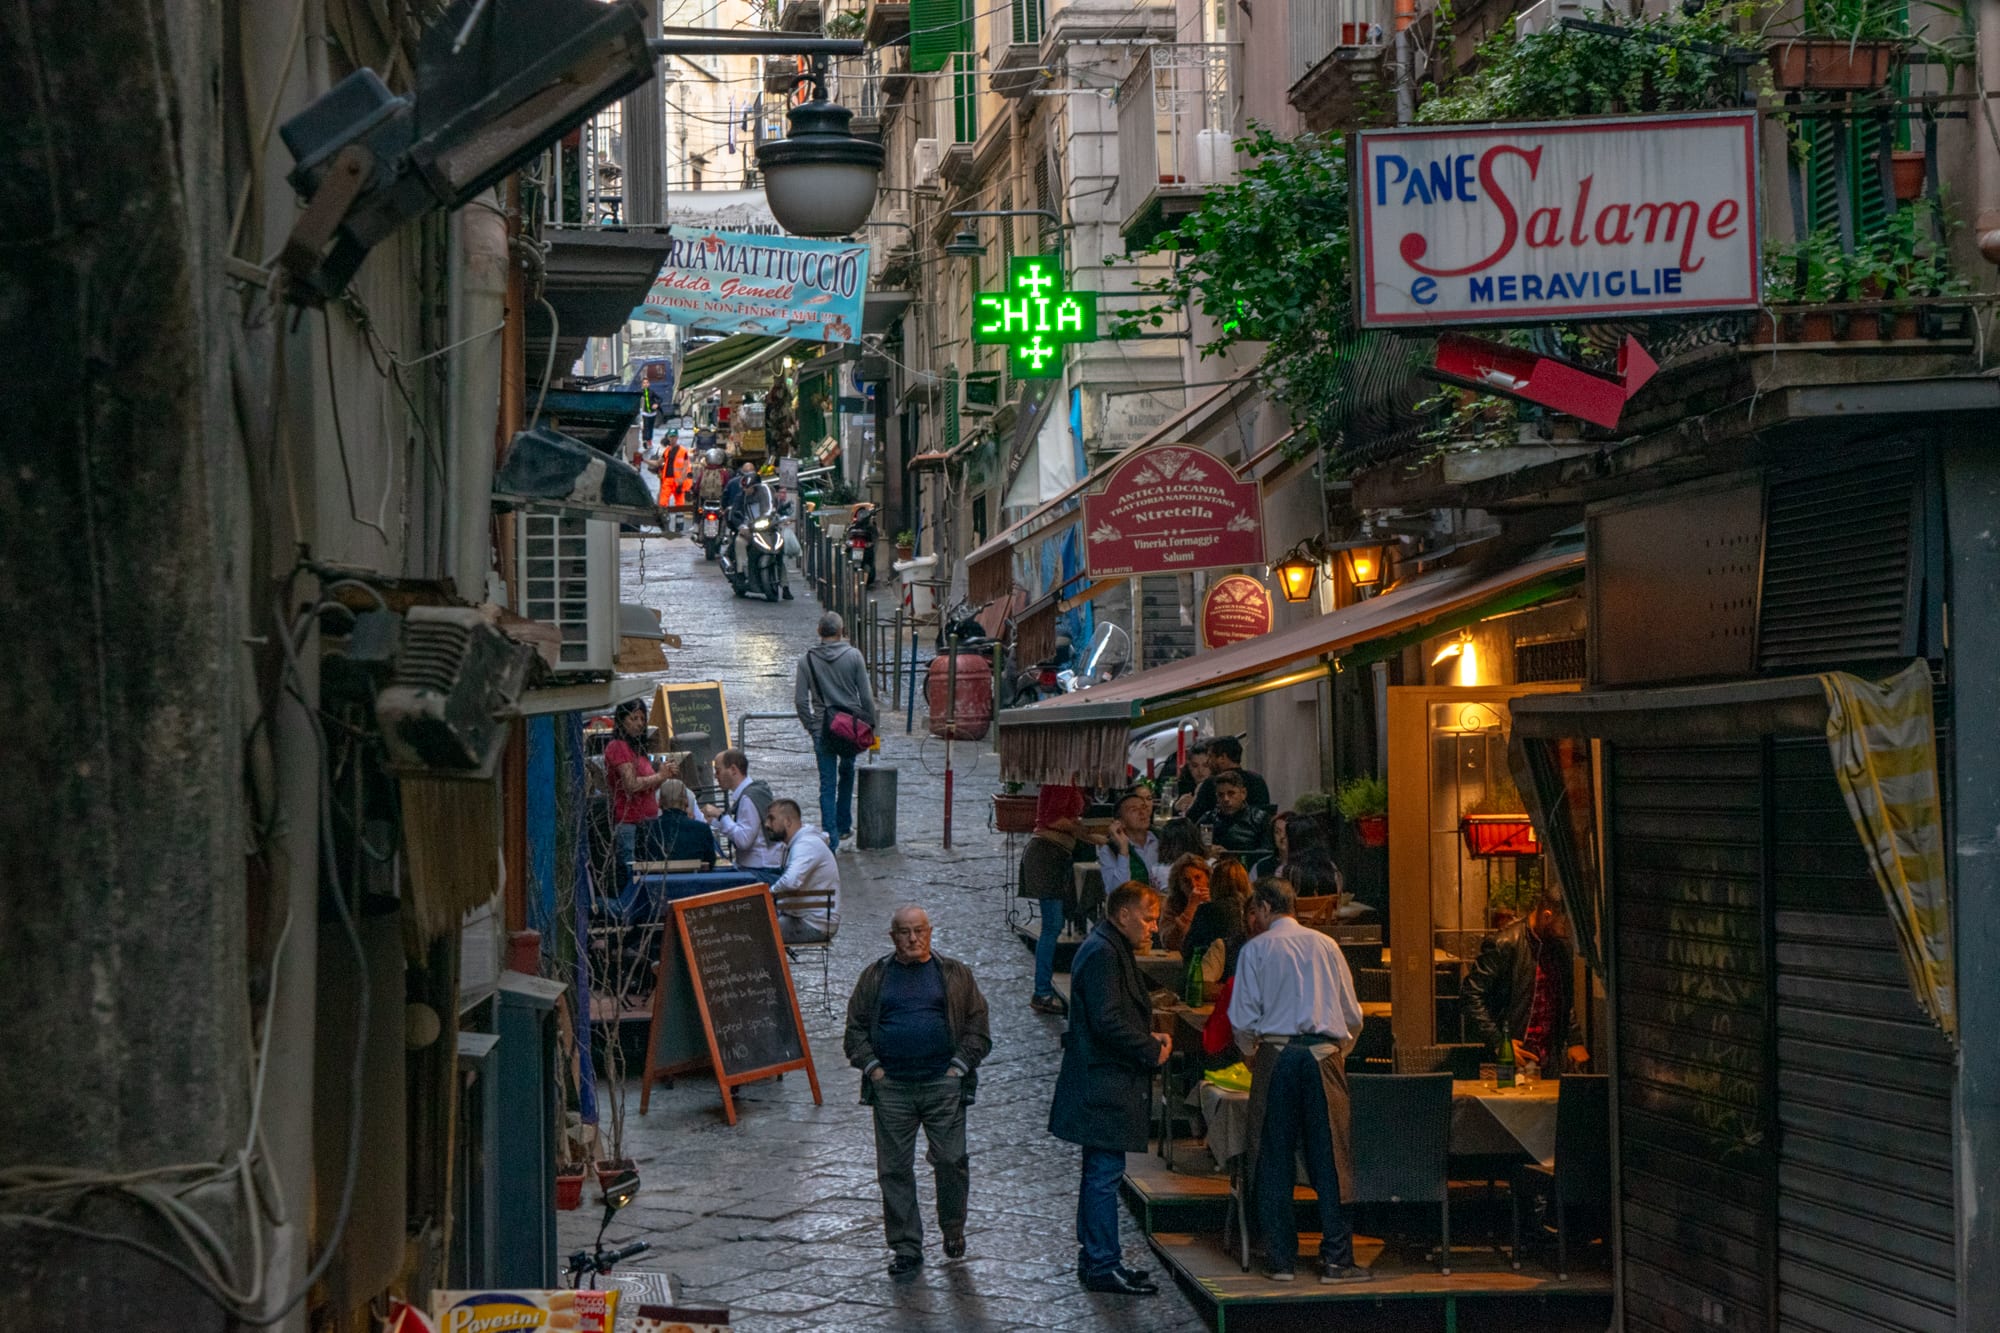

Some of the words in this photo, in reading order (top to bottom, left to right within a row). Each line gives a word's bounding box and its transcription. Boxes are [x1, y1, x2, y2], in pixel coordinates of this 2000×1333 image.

[1375, 153, 1478, 206] PANE
[1399, 144, 1740, 277] Salame
[664, 238, 708, 270] RIA
[713, 243, 857, 298] MATTIUCCIO
[1410, 275, 1439, 305] e
[1469, 267, 1683, 303] MERAVIGLIE
[704, 301, 734, 313] NON
[737, 302, 789, 318] FINISCE
[1110, 495, 1165, 518] TRATTORIA
[1118, 486, 1164, 505] ANTICA
[1166, 484, 1226, 497] LOCANDA
[1169, 535, 1213, 548] Formaggi
[1213, 535, 1220, 544] e
[1162, 550, 1195, 562] Salumi
[452, 1304, 540, 1333] Pavesini
